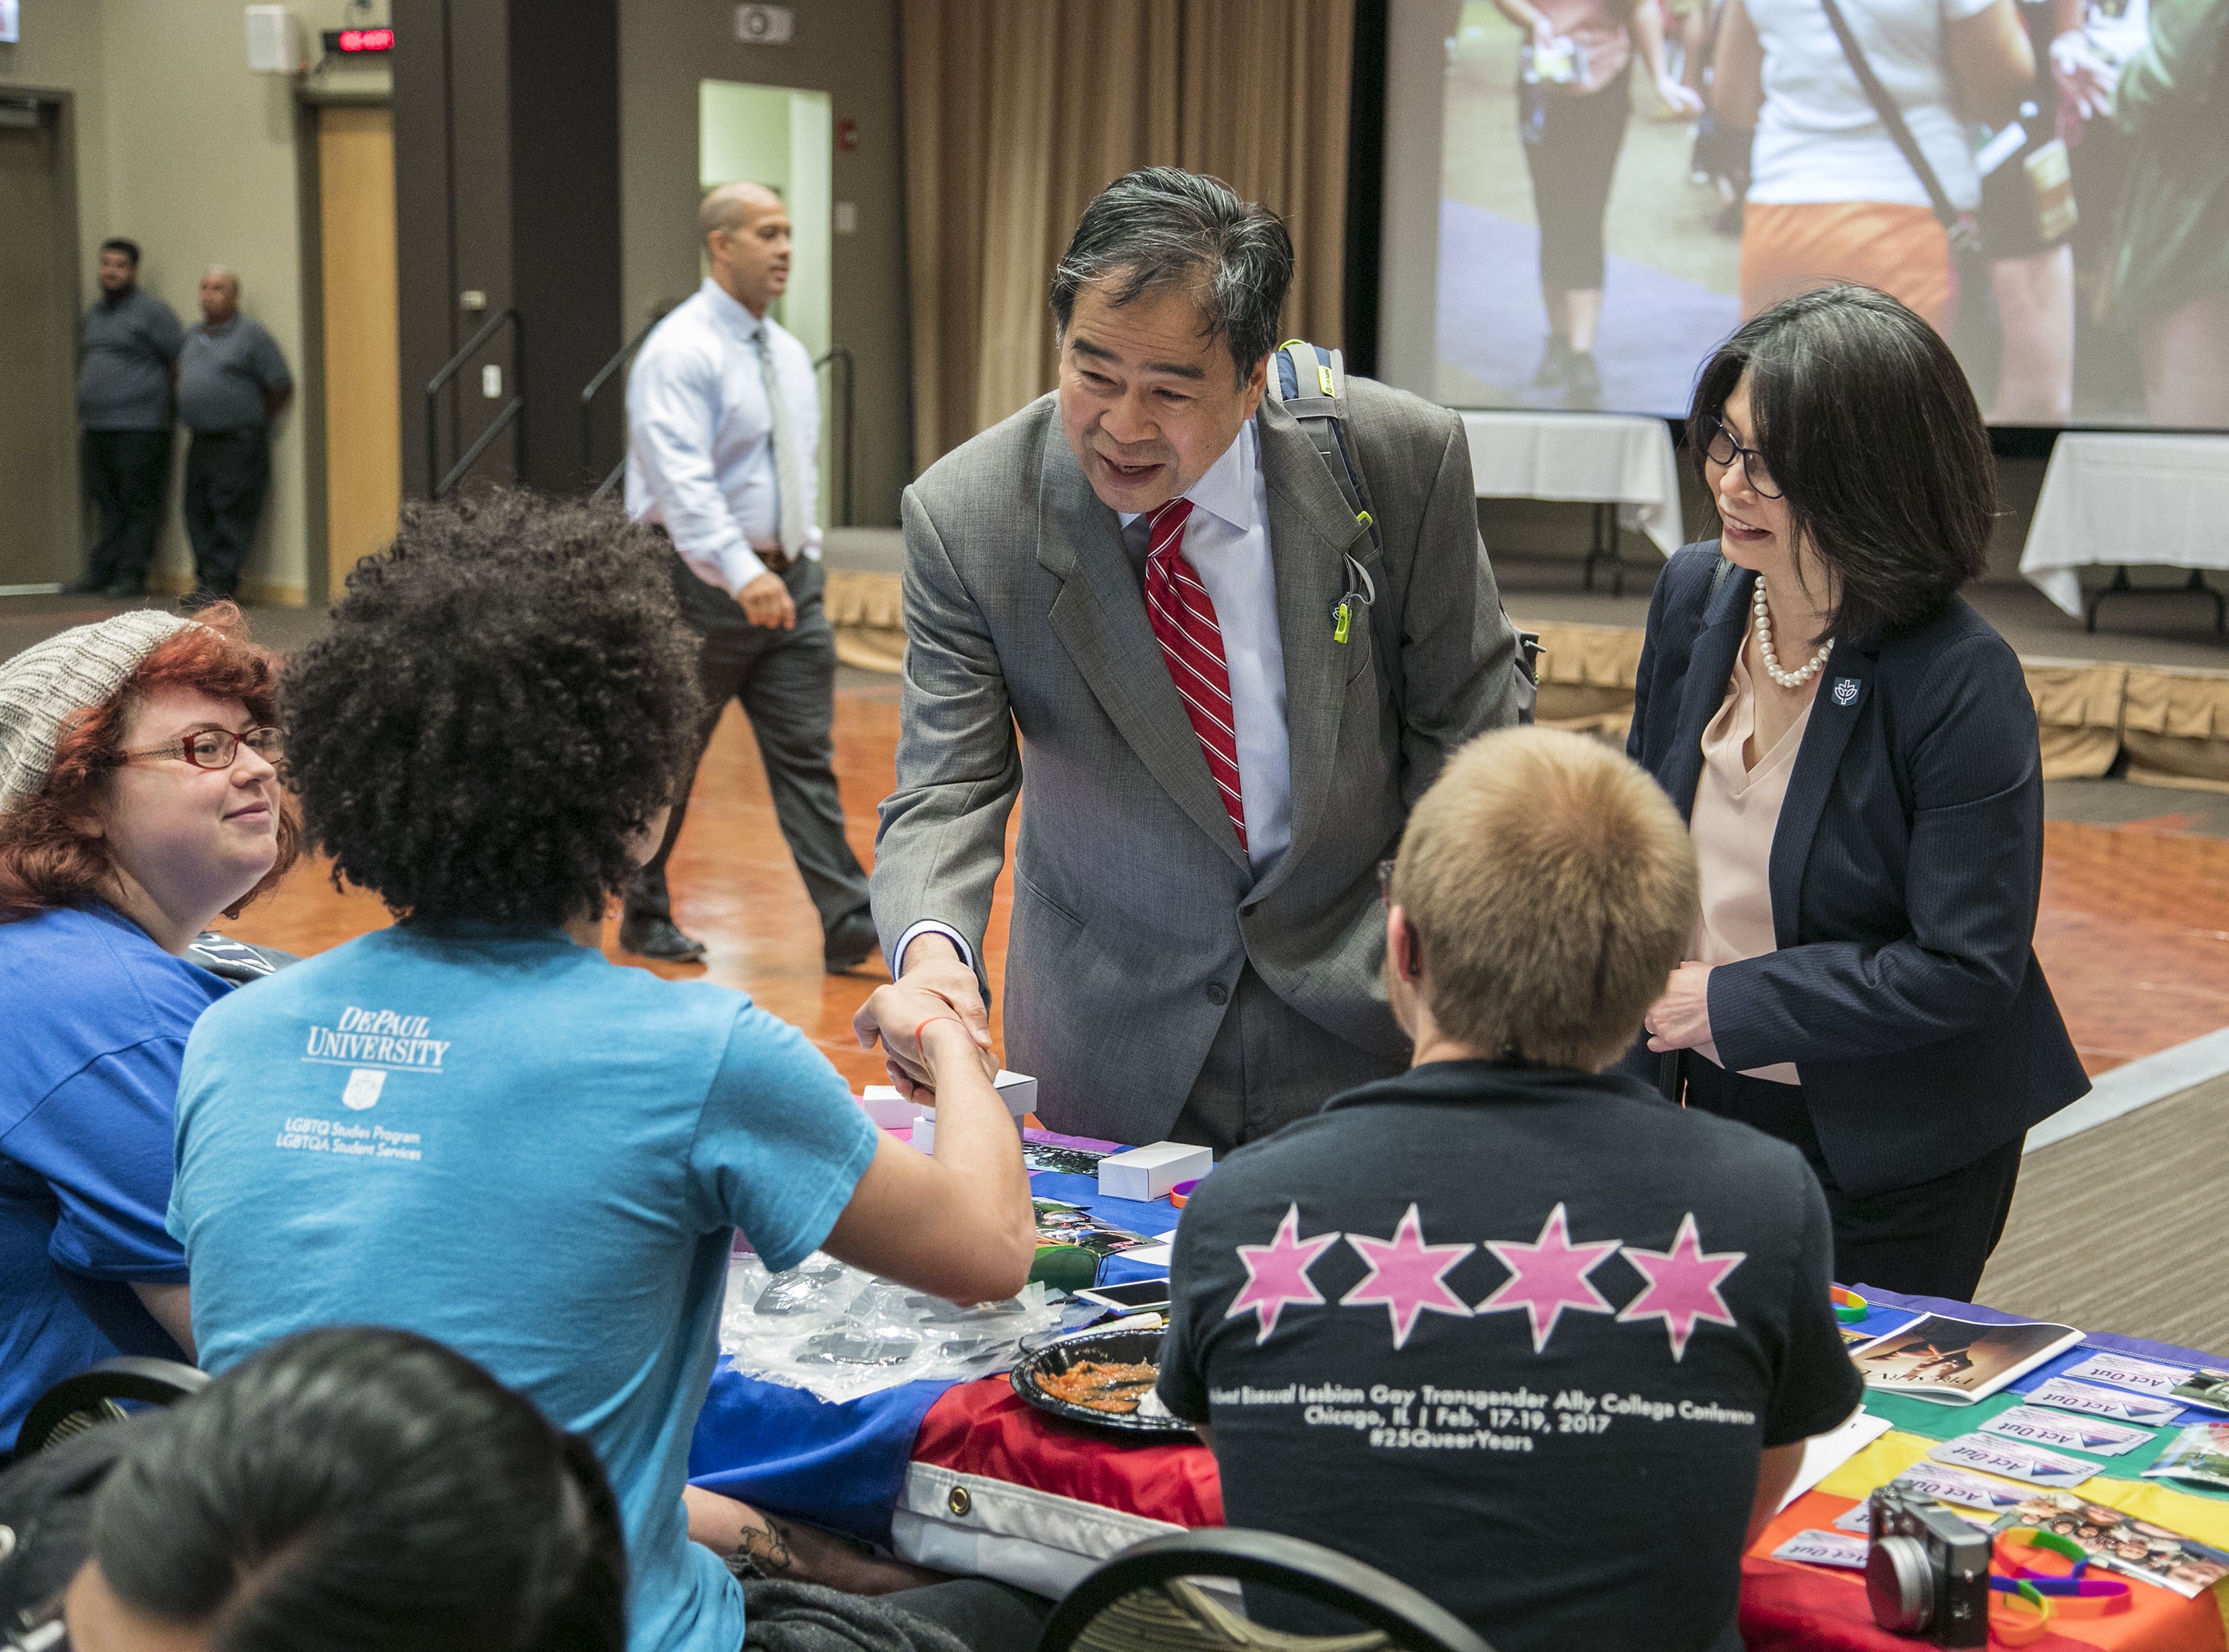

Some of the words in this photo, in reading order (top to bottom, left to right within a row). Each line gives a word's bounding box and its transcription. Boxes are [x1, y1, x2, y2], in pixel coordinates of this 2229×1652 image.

[306, 1026, 451, 1066] UNIVERSITY
[285, 1117, 330, 1136] LGBTQ
[331, 1122, 371, 1139] Studies
[373, 1125, 421, 1145] Program
[276, 1134, 330, 1151] LGBTQA
[331, 1139, 375, 1157] Student
[376, 1142, 422, 1161] Services
[2091, 1368, 2125, 1381] Out
[2129, 1374, 2165, 1387] Act
[1299, 1382, 1365, 1404] Lesbian
[1369, 1384, 1416, 1408] Gay
[1421, 1385, 1548, 1411] Transgender
[1553, 1390, 1596, 1414] Ally
[1600, 1393, 1675, 1422] College
[2043, 1393, 2077, 1406] Out
[2081, 1399, 2118, 1413] Act
[1304, 1405, 1386, 1430] Chicago,
[1392, 1405, 1411, 1427] IL
[1435, 1405, 1479, 1427] Feb.
[1490, 1408, 1551, 1434] 17-19,
[1559, 1412, 1612, 1434] 2017
[1998, 1422, 2034, 1437] Out
[2037, 1430, 2075, 1444] Act
[1369, 1427, 1534, 1452] #25QueerYears
[1950, 1446, 1989, 1462] Out
[1990, 1454, 2027, 1471] Act
[1944, 1487, 1982, 1502] Act
